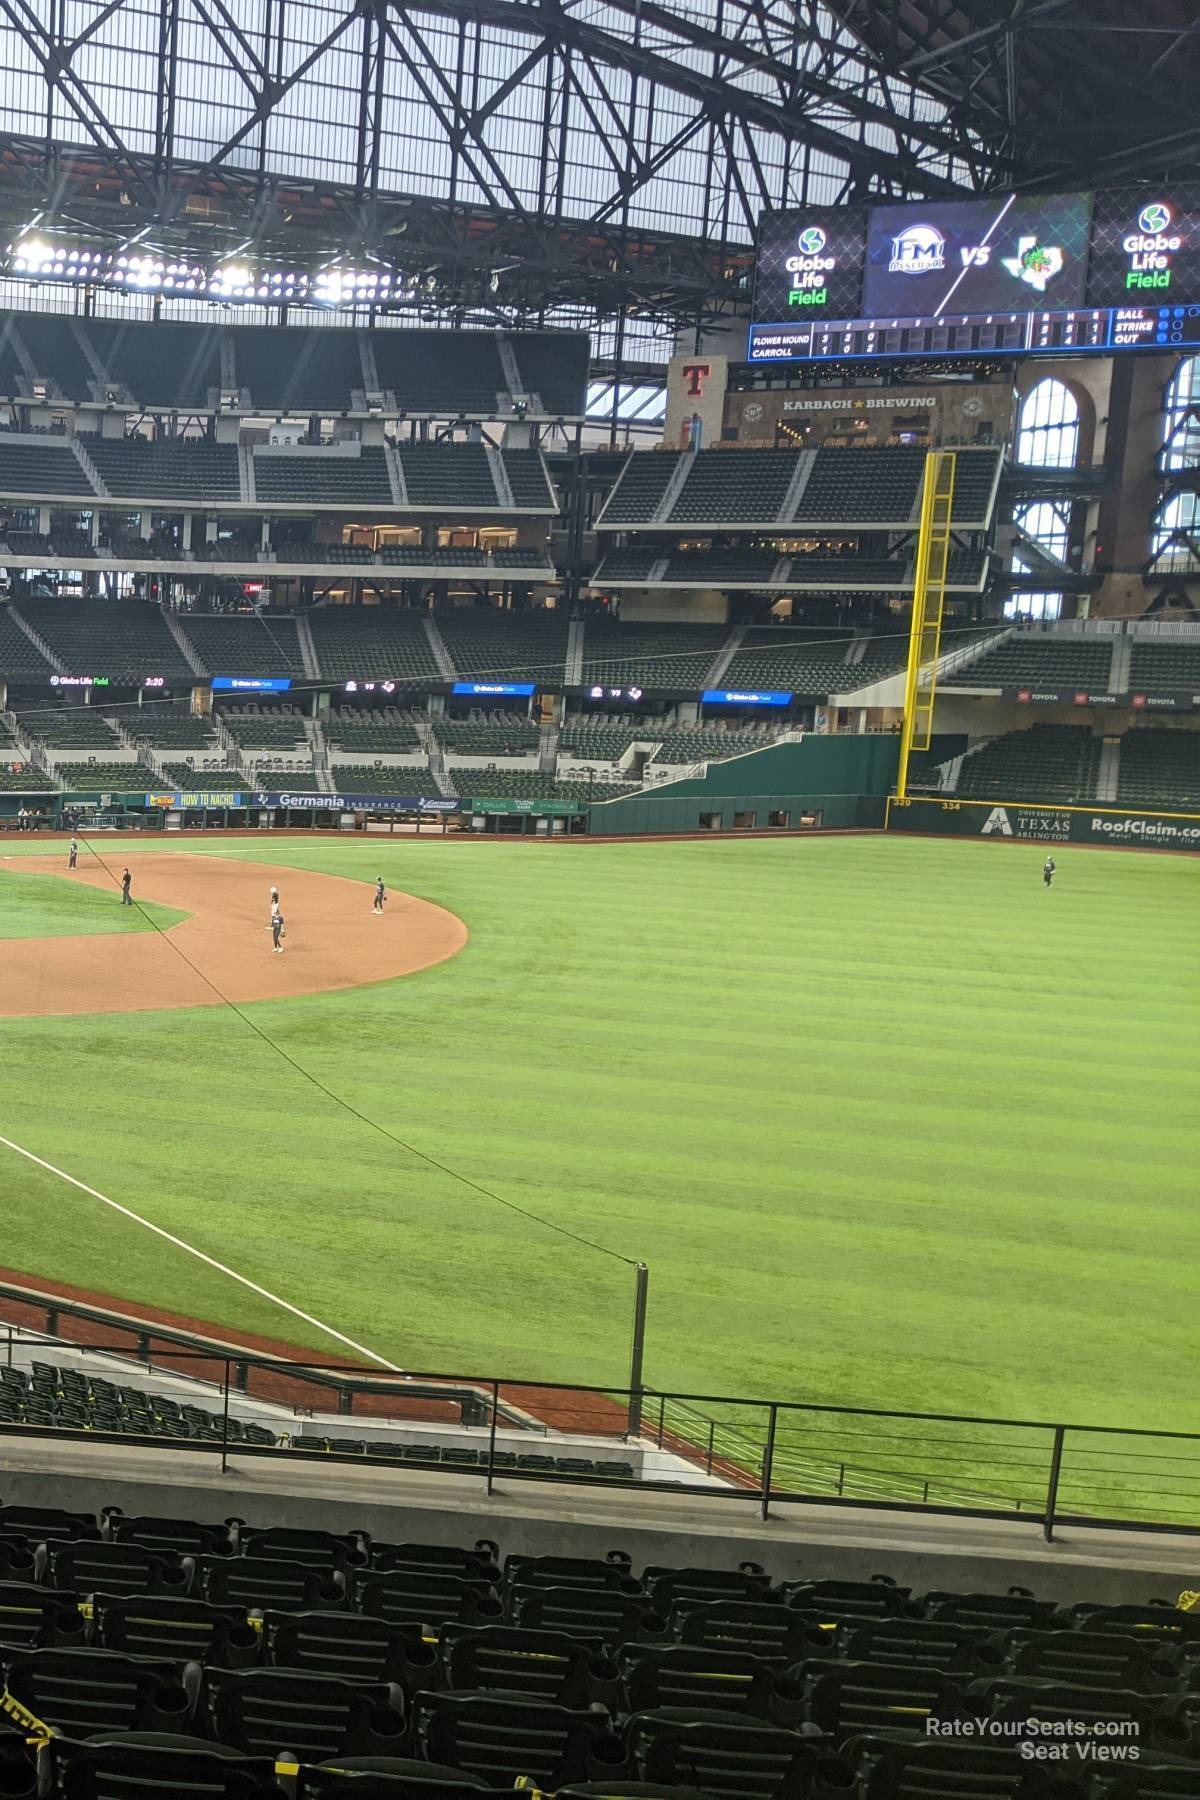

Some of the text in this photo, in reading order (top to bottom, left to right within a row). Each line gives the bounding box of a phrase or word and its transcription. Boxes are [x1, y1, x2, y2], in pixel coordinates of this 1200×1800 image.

[1123, 234, 1181, 252] Globe
[785, 255, 836, 271] Globe
[960, 246, 991, 267] VS
[1131, 252, 1168, 270] Life
[793, 271, 825, 288] Life
[1126, 270, 1171, 288] Field
[788, 288, 827, 305] Field
[1116, 310, 1144, 320] BALL
[1114, 321, 1154, 331] STRIKE
[753, 336, 781, 346] FLOWER
[781, 335, 809, 344] MOUND
[1114, 334, 1139, 344] OUT
[752, 348, 792, 358] CARROLL
[682, 365, 710, 395] T
[783, 397, 936, 411] KARBACH BREWING
[60, 677, 108, 686] Globe Life Field
[145, 677, 164, 686] 3:20
[181, 794, 198, 806] HOW
[199, 794, 209, 806] TO
[210, 794, 235, 805] NACHO.
[279, 794, 345, 807] Germania
[347, 801, 401, 809] INSURANCE
[941, 802, 960, 810] 334
[1018, 810, 1060, 818] UNIVERSITY
[1017, 817, 1070, 832] TEXAS
[1016, 831, 1069, 841] ARLINGTON
